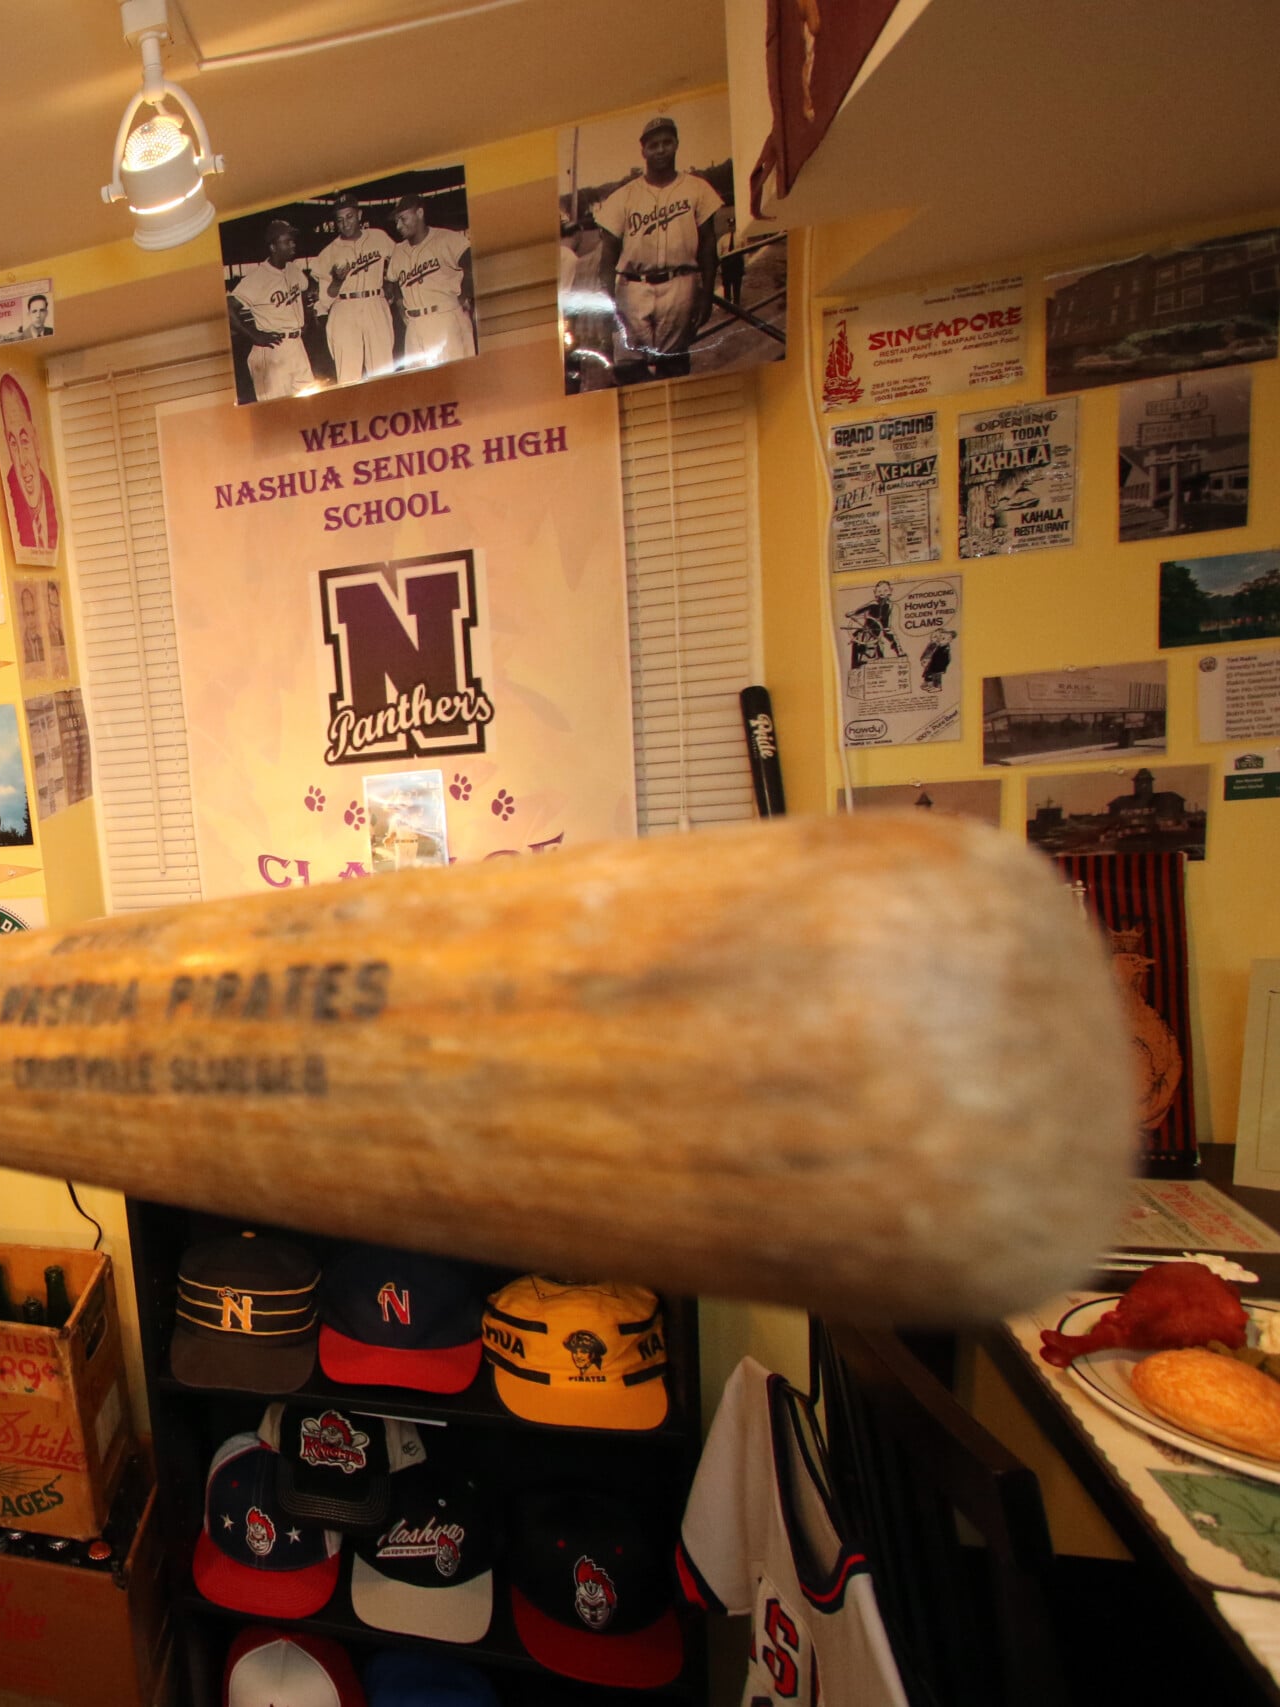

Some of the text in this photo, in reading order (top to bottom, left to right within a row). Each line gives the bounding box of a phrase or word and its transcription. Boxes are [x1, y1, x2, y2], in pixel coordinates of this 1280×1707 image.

[629, 197, 691, 236] Dodgers
[346, 250, 382, 273] odgers
[398, 257, 441, 287] Dodgers
[867, 306, 1023, 351] SINGAPORE
[880, 342, 932, 357] RESTAURANT
[977, 328, 1014, 341] LOUNGE
[300, 401, 462, 453] WELCOME
[834, 414, 934, 447] GRAND OPENING
[1011, 424, 1050, 441] TODAY
[215, 426, 569, 509] NASHUA SENIOR HIGH
[879, 457, 936, 482] KEMP'S
[970, 445, 1051, 474] KAHALA
[323, 490, 451, 532] SCHOOL
[1021, 508, 1064, 525] KAHALA
[1013, 520, 1070, 537] RESTAURANT
[904, 599, 947, 612] Howdy's
[904, 617, 945, 630] CLAMS
[221, 1295, 254, 1332] N
[381, 1288, 412, 1326] N
[568, 1375, 607, 1383] PIRATES
